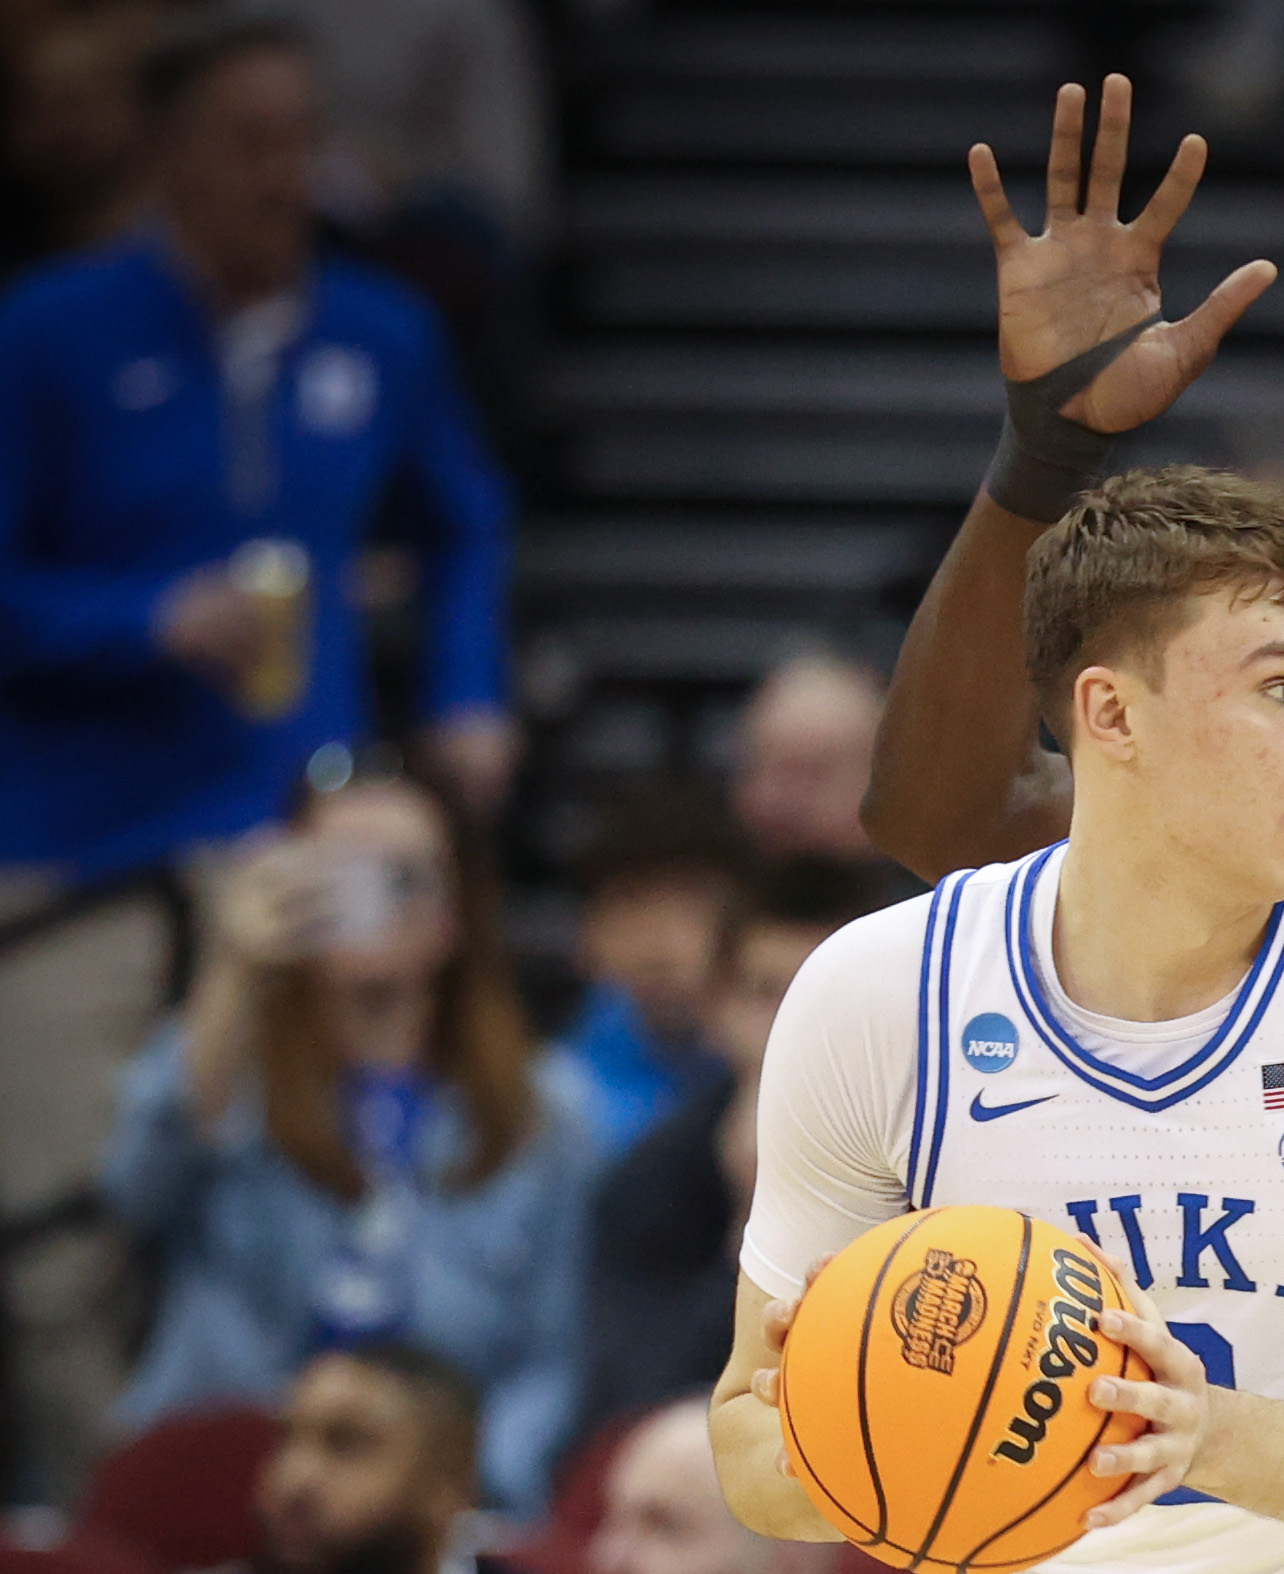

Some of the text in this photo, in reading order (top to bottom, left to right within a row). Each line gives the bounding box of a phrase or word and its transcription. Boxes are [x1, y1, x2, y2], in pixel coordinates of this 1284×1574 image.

[967, 1040, 1015, 1059] NCAA
[902, 1273, 948, 1369] MADNESS
[934, 1267, 971, 1340] MARCH
[991, 1248, 1104, 1466] Wilson
